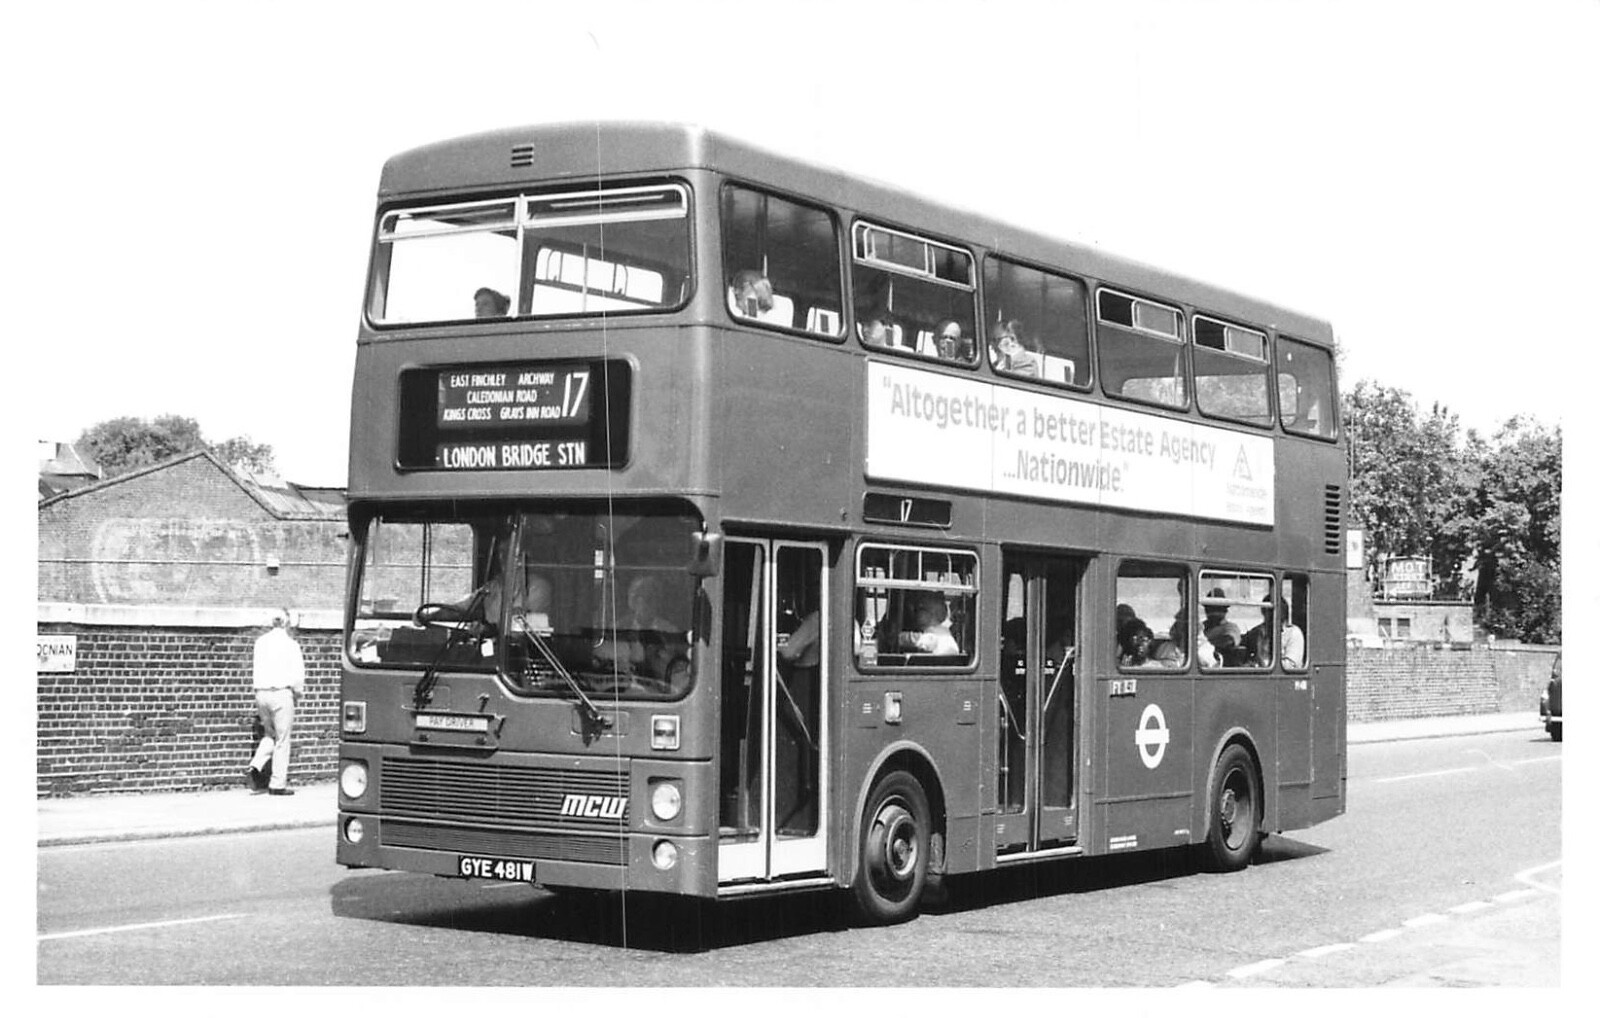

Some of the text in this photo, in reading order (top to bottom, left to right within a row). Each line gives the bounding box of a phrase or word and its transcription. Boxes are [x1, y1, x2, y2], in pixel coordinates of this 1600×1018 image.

[450, 372, 555, 387] EAST FINCHLEY ARCHWAY
[466, 389, 538, 404] CALEDONIAN ROAD
[562, 371, 589, 417] 17
[443, 408, 467, 421] KINGS
[467, 407, 492, 420] CROSS
[526, 406, 540, 419] INN
[540, 405, 561, 419] ROAD
[1016, 409, 1027, 435] a
[1033, 407, 1096, 446] better
[1100, 420, 1154, 456] Estate
[1160, 430, 1216, 472] Agency
[443, 442, 585, 468] LONDON BRIDGE STN
[901, 499, 912, 522] 17
[560, 794, 628, 818] MCW
[461, 858, 533, 881] GYE 481W
